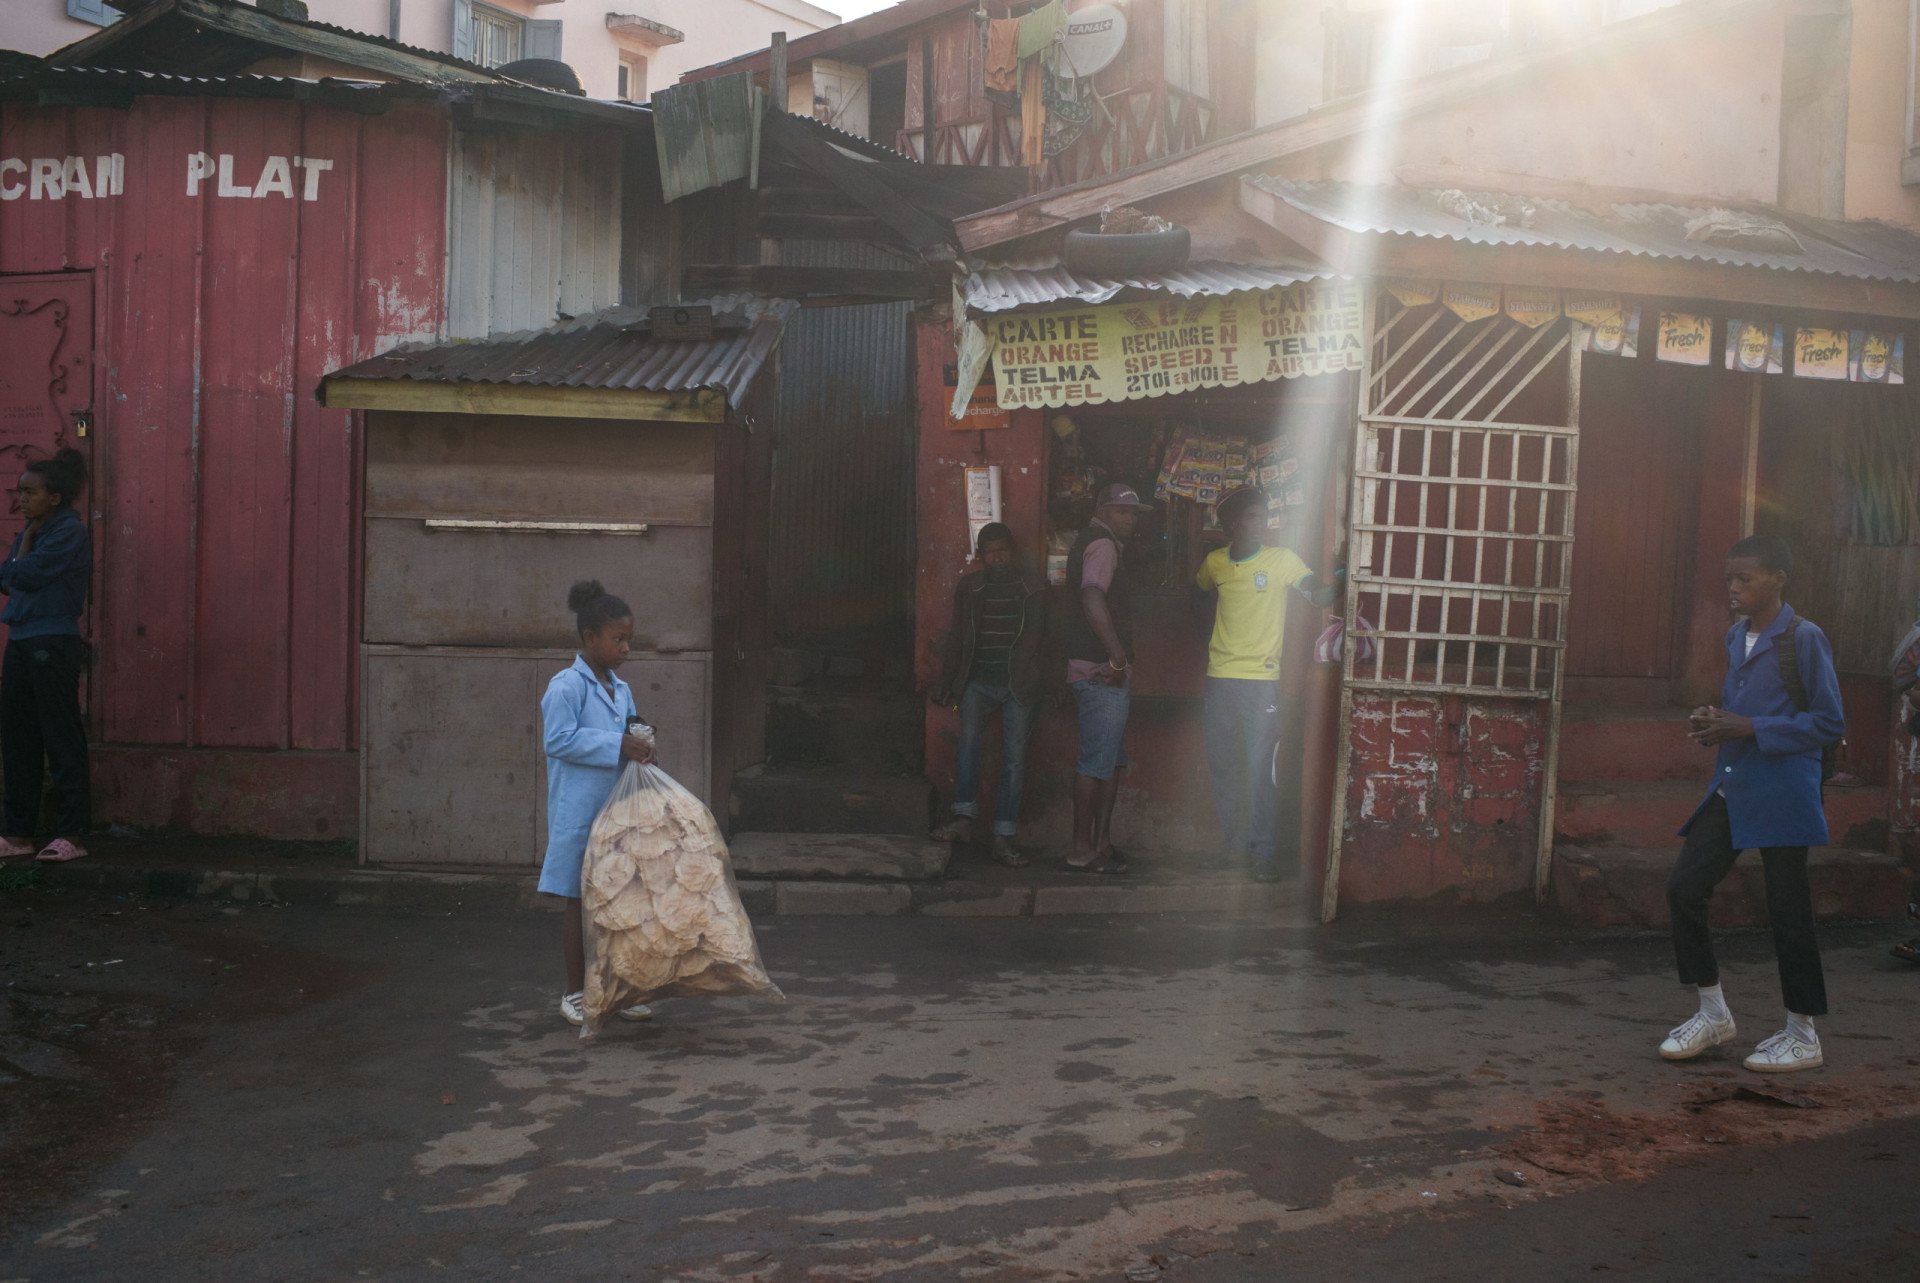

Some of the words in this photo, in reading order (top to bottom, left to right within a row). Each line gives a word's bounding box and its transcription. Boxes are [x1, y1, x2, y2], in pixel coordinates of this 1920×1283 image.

[1070, 21, 1111, 34] CANAL+
[187, 151, 333, 201] PLAT
[1259, 284, 1358, 316] CARTE
[998, 315, 1098, 344] CARTE
[1262, 311, 1359, 338] ORANGE
[1122, 326, 1214, 355] RECHARGE
[1264, 333, 1361, 357] TELMA
[1665, 328, 1704, 348] Fresh
[1000, 342, 1099, 366] ORANGE
[1125, 348, 1213, 374] SPEED
[1800, 342, 1841, 363] Fresh
[1002, 365, 1101, 385] TELMA
